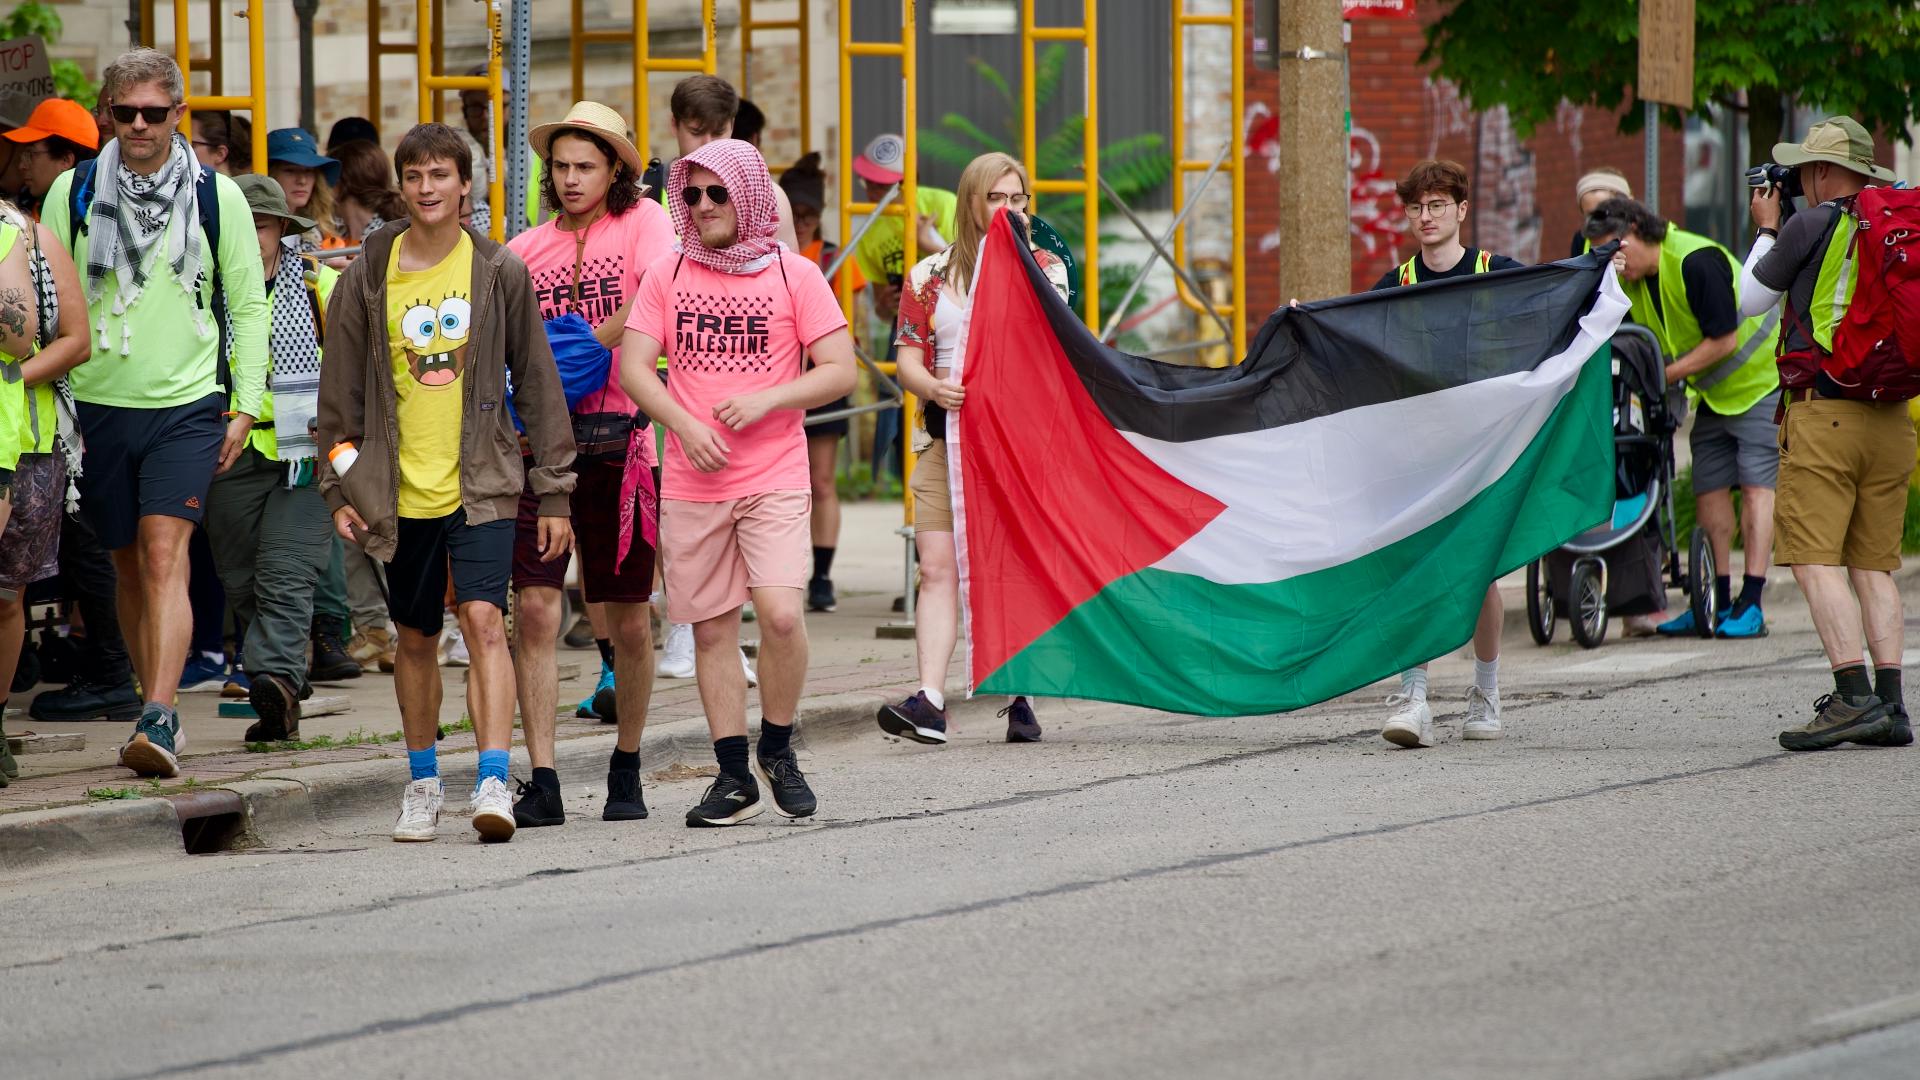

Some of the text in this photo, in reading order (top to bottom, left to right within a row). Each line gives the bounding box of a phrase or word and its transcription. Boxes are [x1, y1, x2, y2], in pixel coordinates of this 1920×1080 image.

[536, 276, 622, 308] FREE
[541, 296, 622, 320] ASTINE
[676, 311, 769, 335] FREE
[676, 331, 769, 354] PALESTINE
